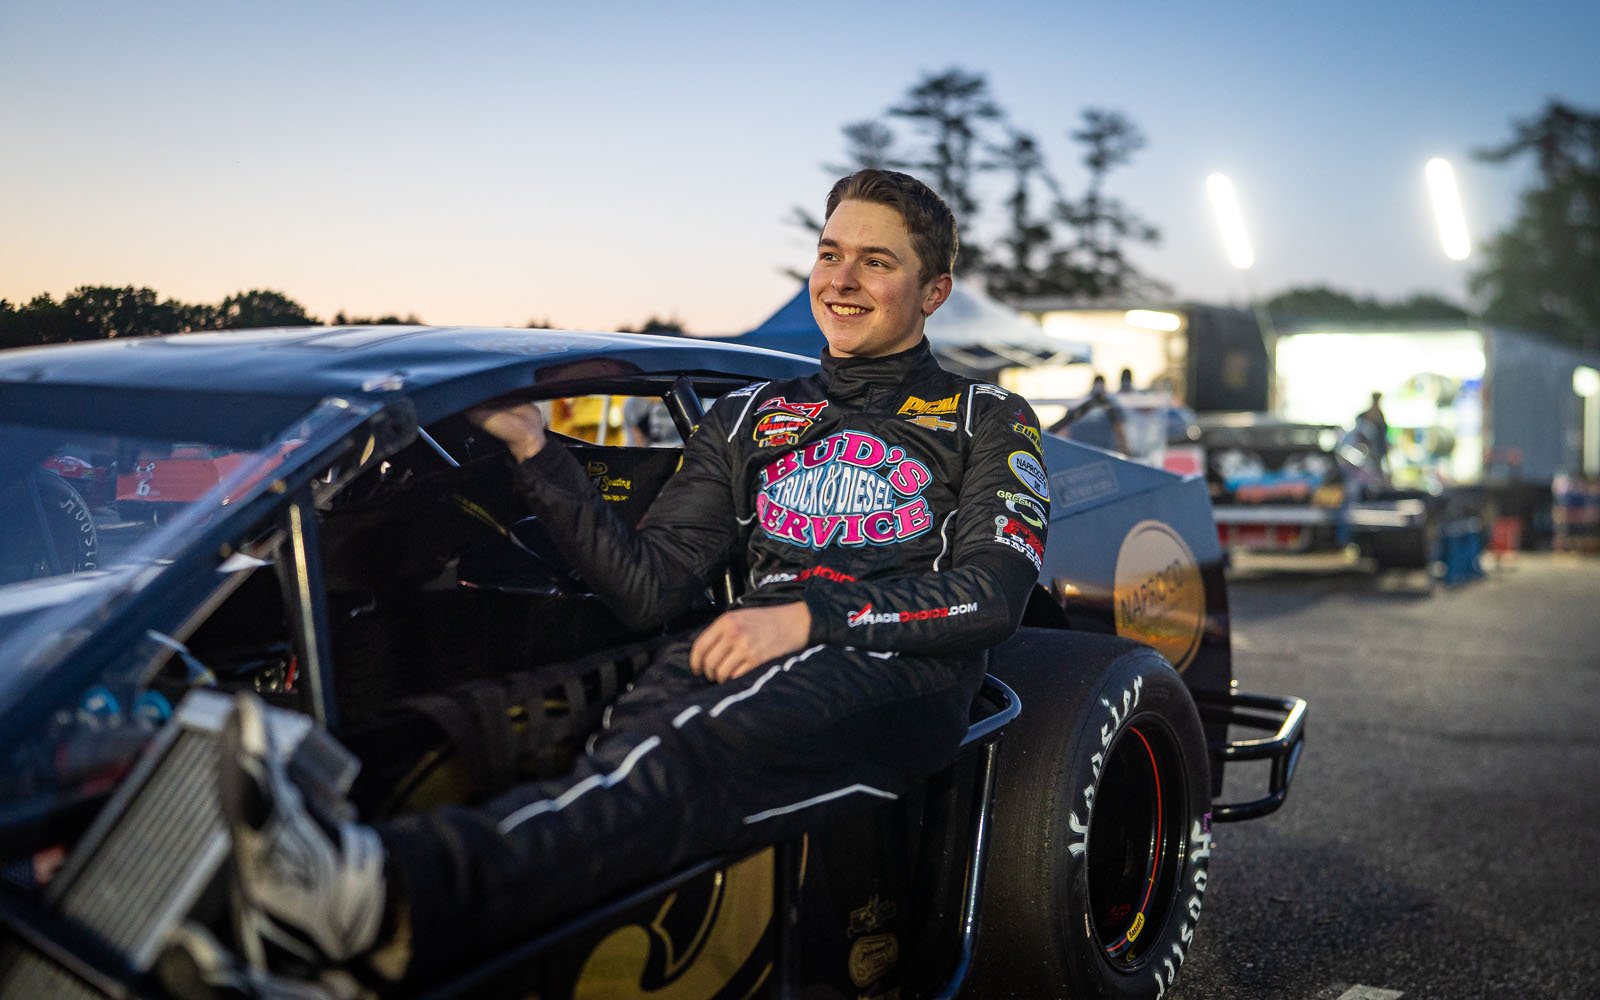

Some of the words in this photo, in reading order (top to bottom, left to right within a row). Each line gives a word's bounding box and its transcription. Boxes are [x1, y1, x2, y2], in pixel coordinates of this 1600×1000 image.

[761, 431, 931, 496] BUD'S
[775, 467, 823, 514] TRUCK
[819, 463, 841, 515] &
[836, 465, 894, 514] DIESEL
